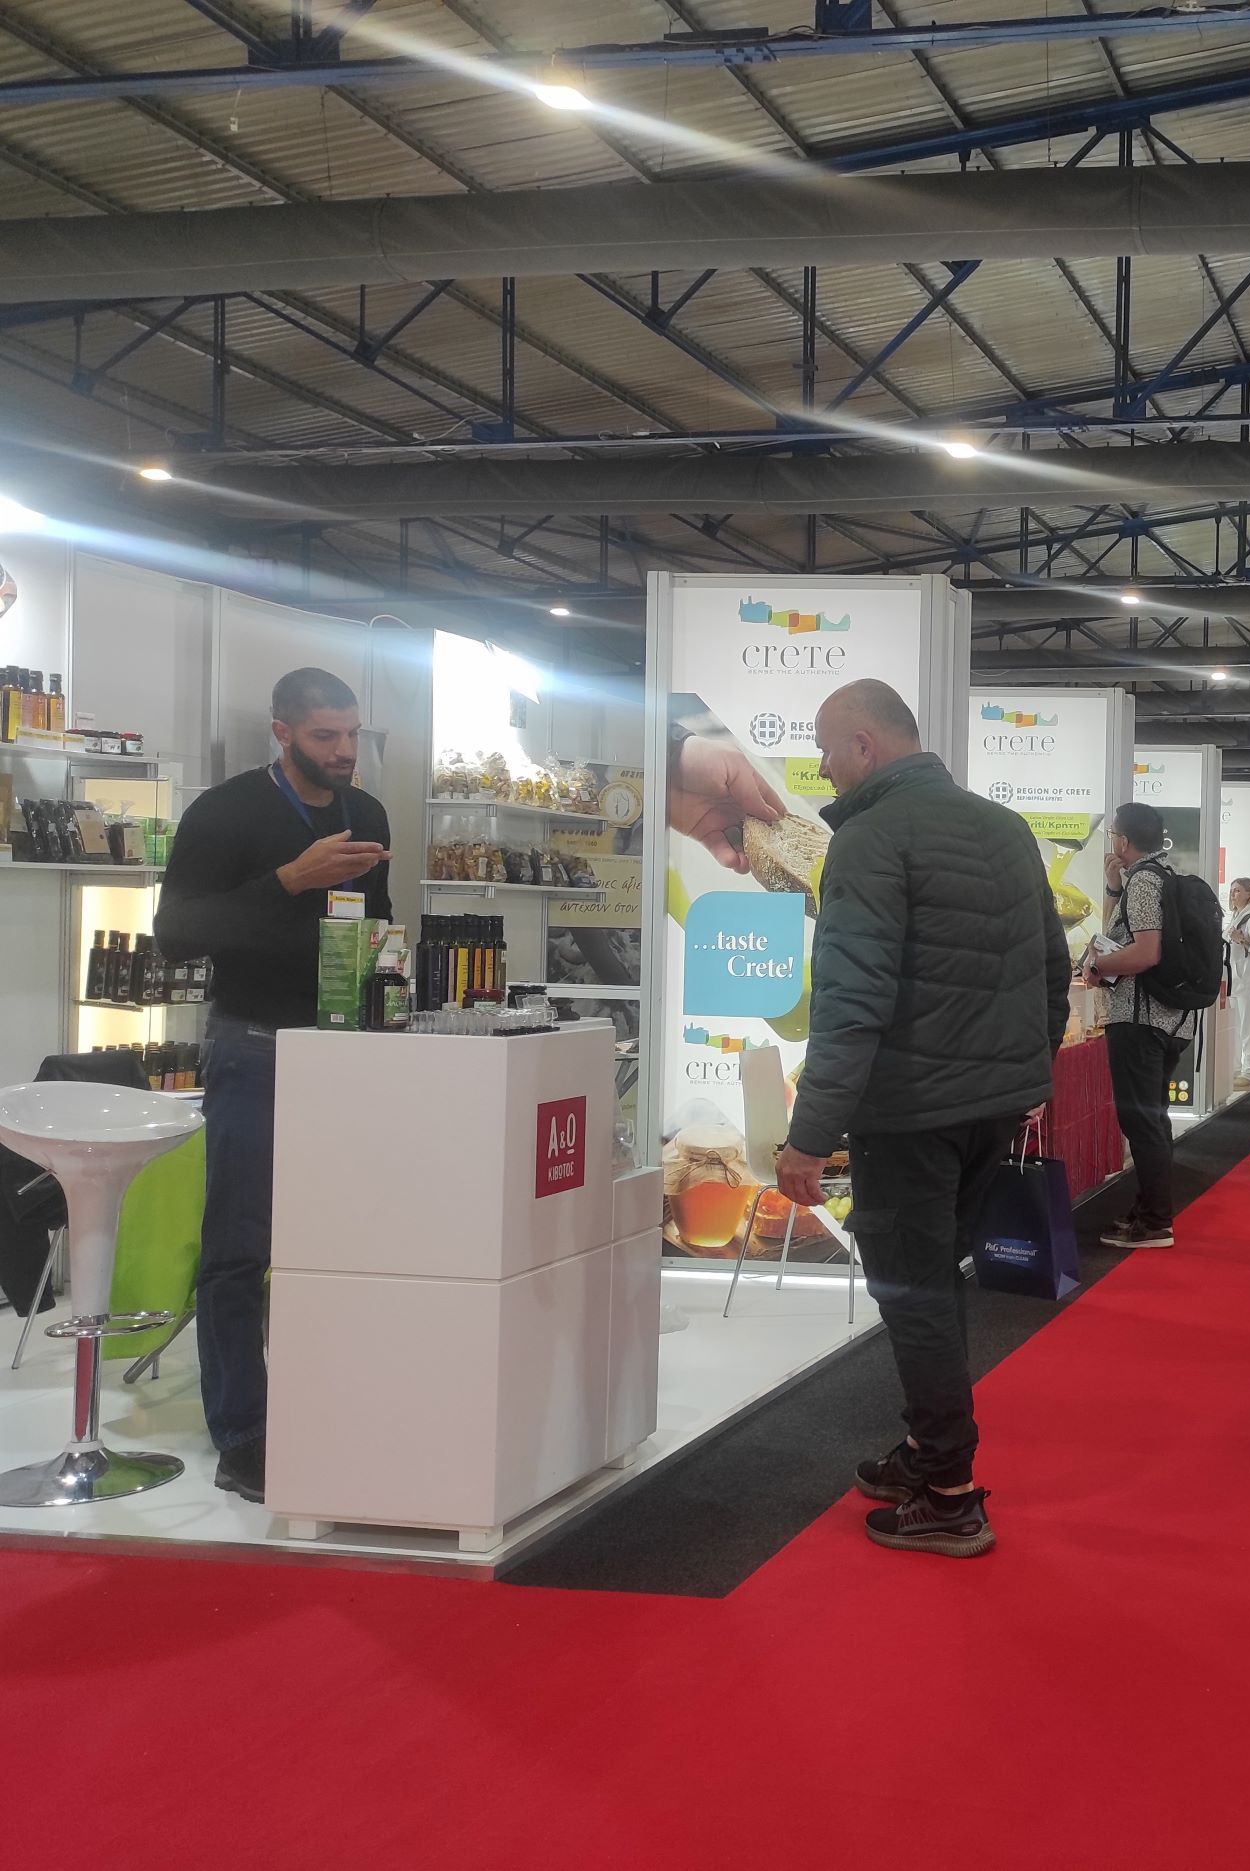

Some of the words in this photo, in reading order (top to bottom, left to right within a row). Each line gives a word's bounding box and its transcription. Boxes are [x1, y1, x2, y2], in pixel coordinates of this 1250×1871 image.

[790, 722, 814, 732] REG
[1017, 787, 1049, 795] REGION
[1066, 788, 1091, 796] CRETE
[727, 955, 794, 979] Crete!
